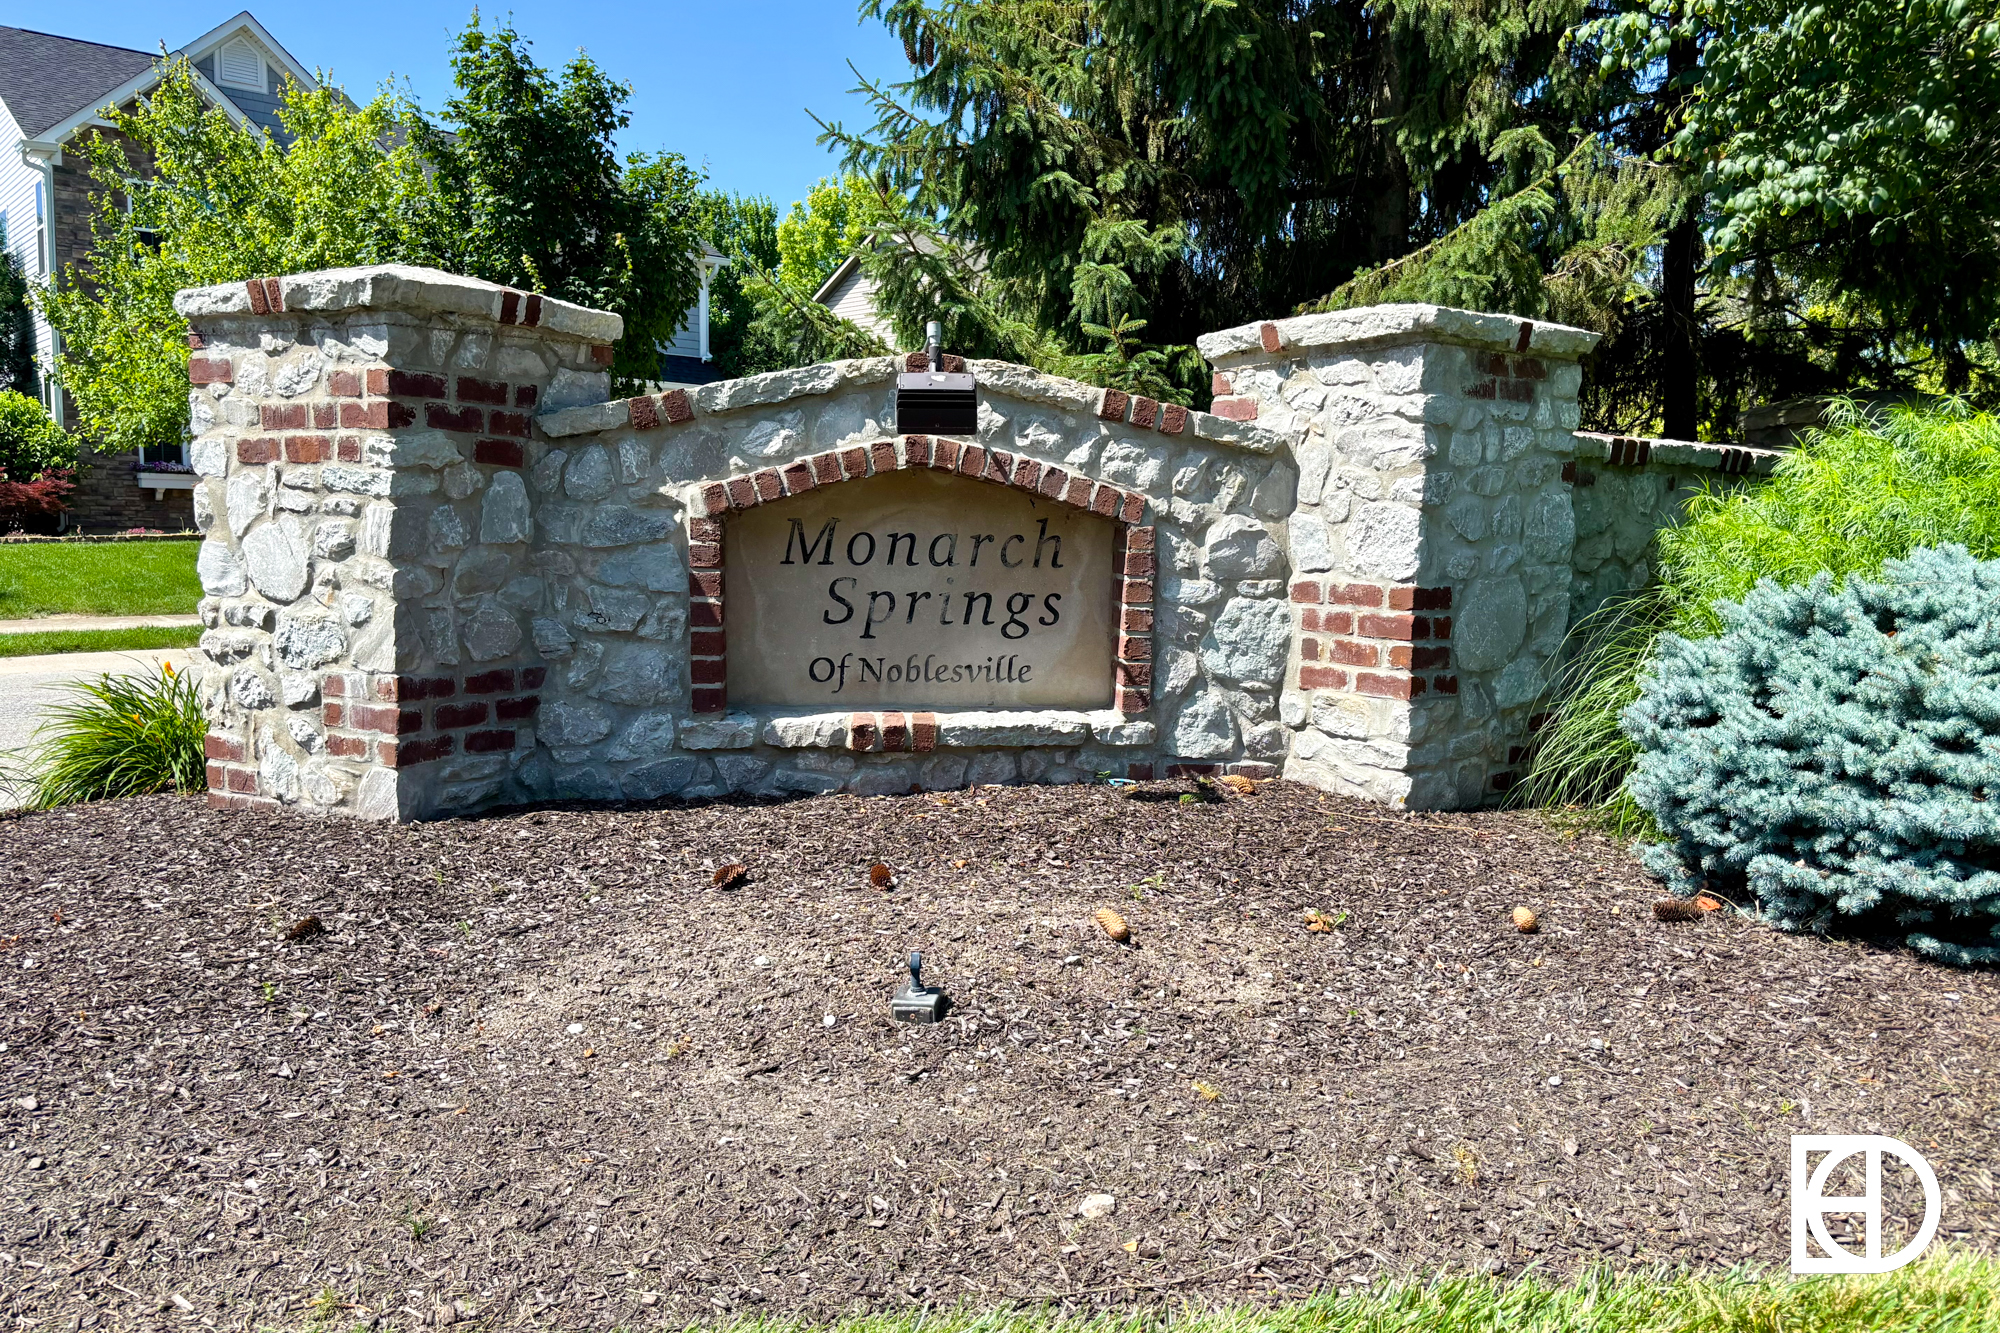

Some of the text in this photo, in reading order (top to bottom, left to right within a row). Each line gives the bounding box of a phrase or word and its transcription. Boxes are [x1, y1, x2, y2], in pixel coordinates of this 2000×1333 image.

[780, 517, 1064, 568] Monarch
[823, 576, 1062, 640] Springs
[808, 652, 1033, 694] Of Noblesville
